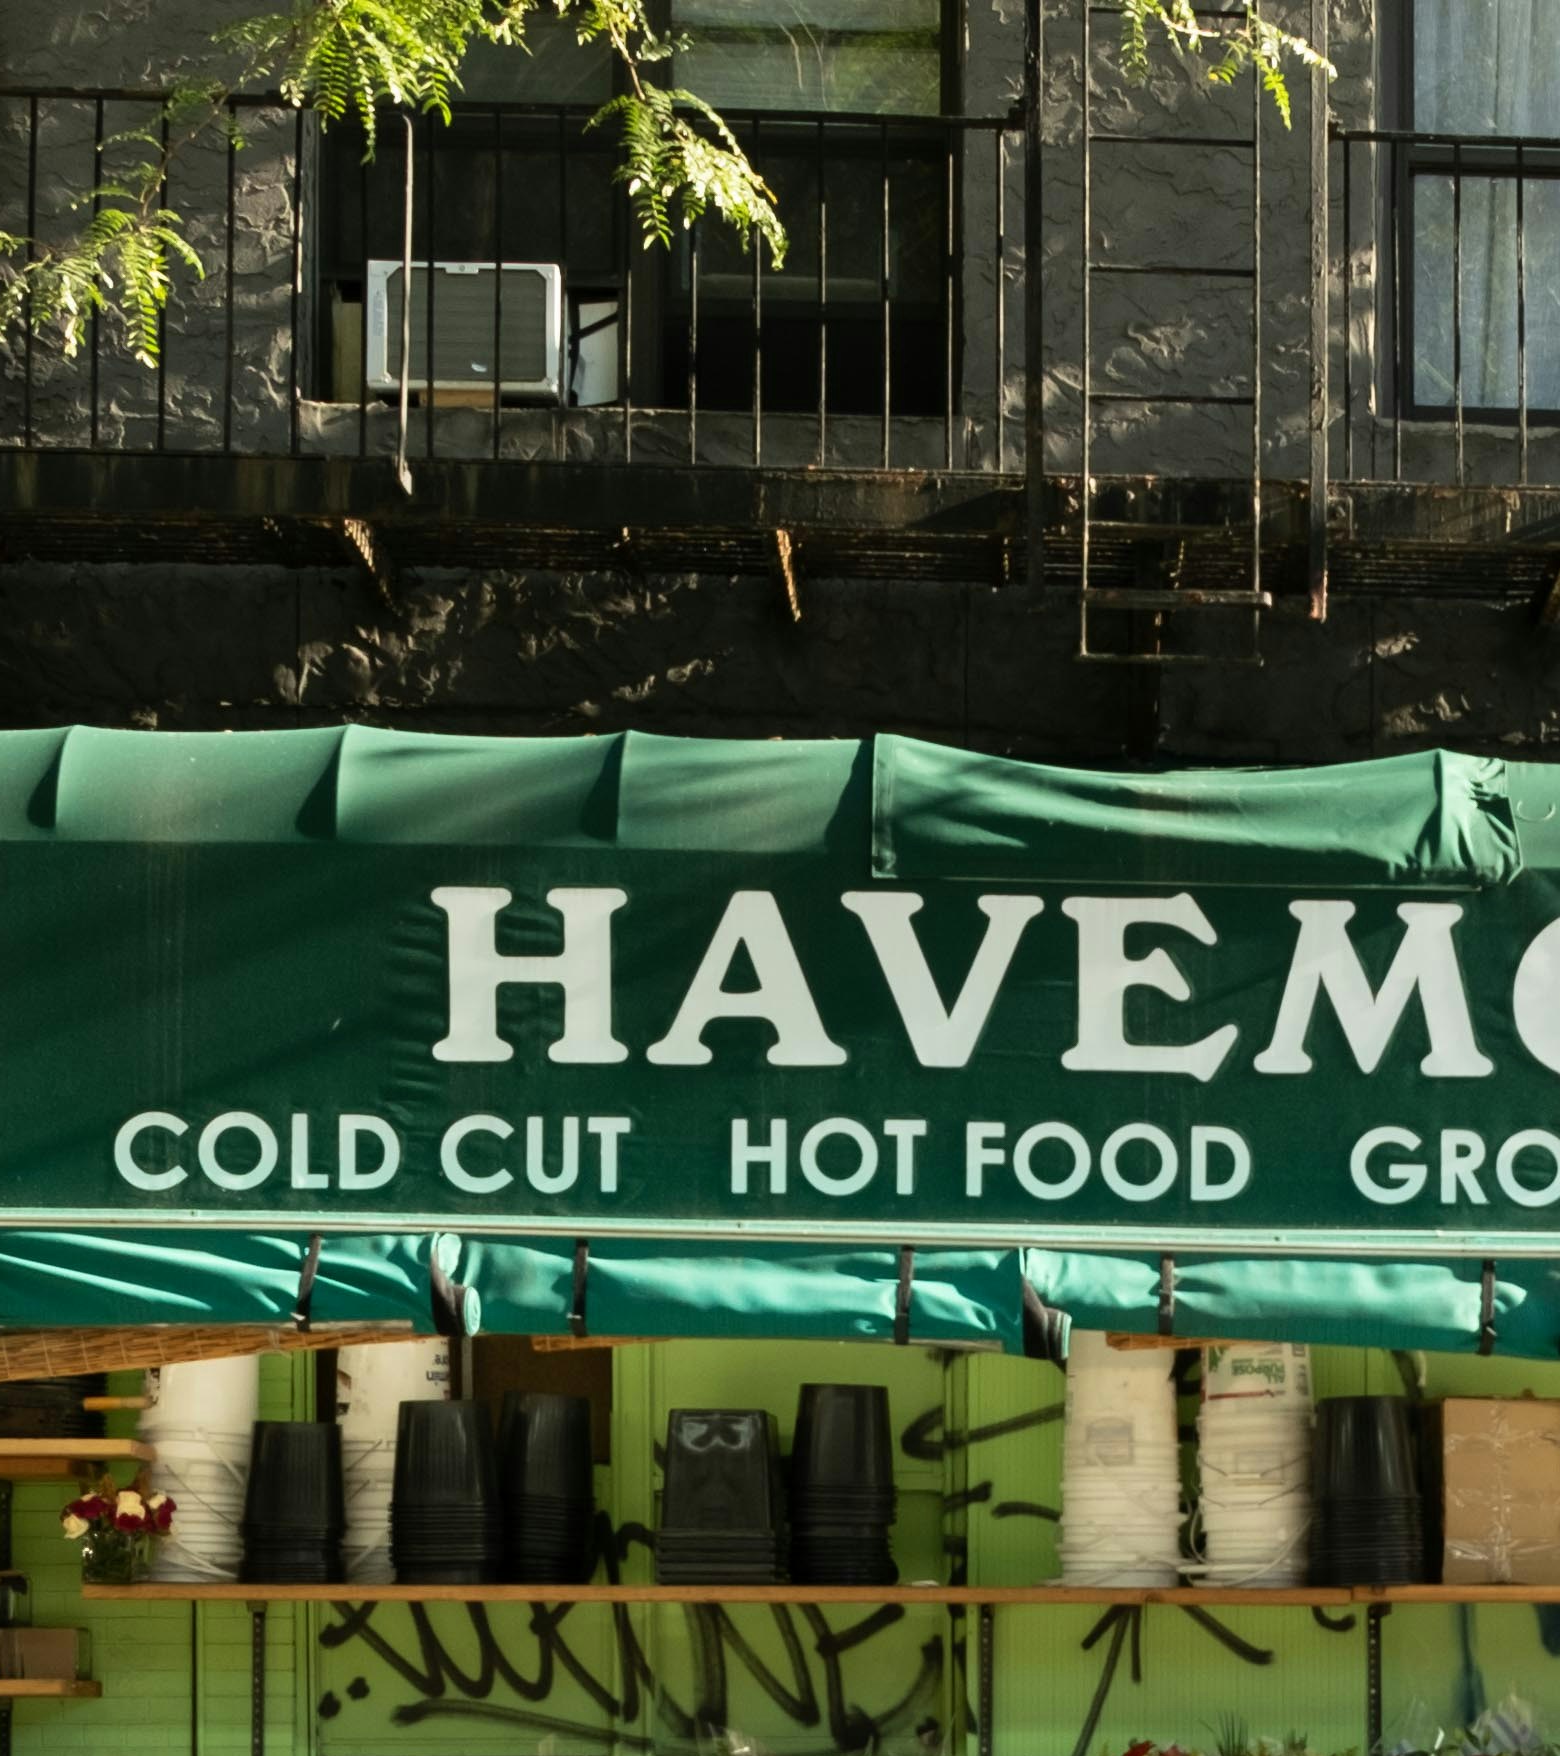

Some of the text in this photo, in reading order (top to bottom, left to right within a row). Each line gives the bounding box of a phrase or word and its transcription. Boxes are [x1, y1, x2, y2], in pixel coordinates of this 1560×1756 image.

[114, 1112, 401, 1191] COLD
[440, 1115, 631, 1194] CUT
[731, 1118, 927, 1201] HOT
[966, 1121, 1252, 1203] FOOD
